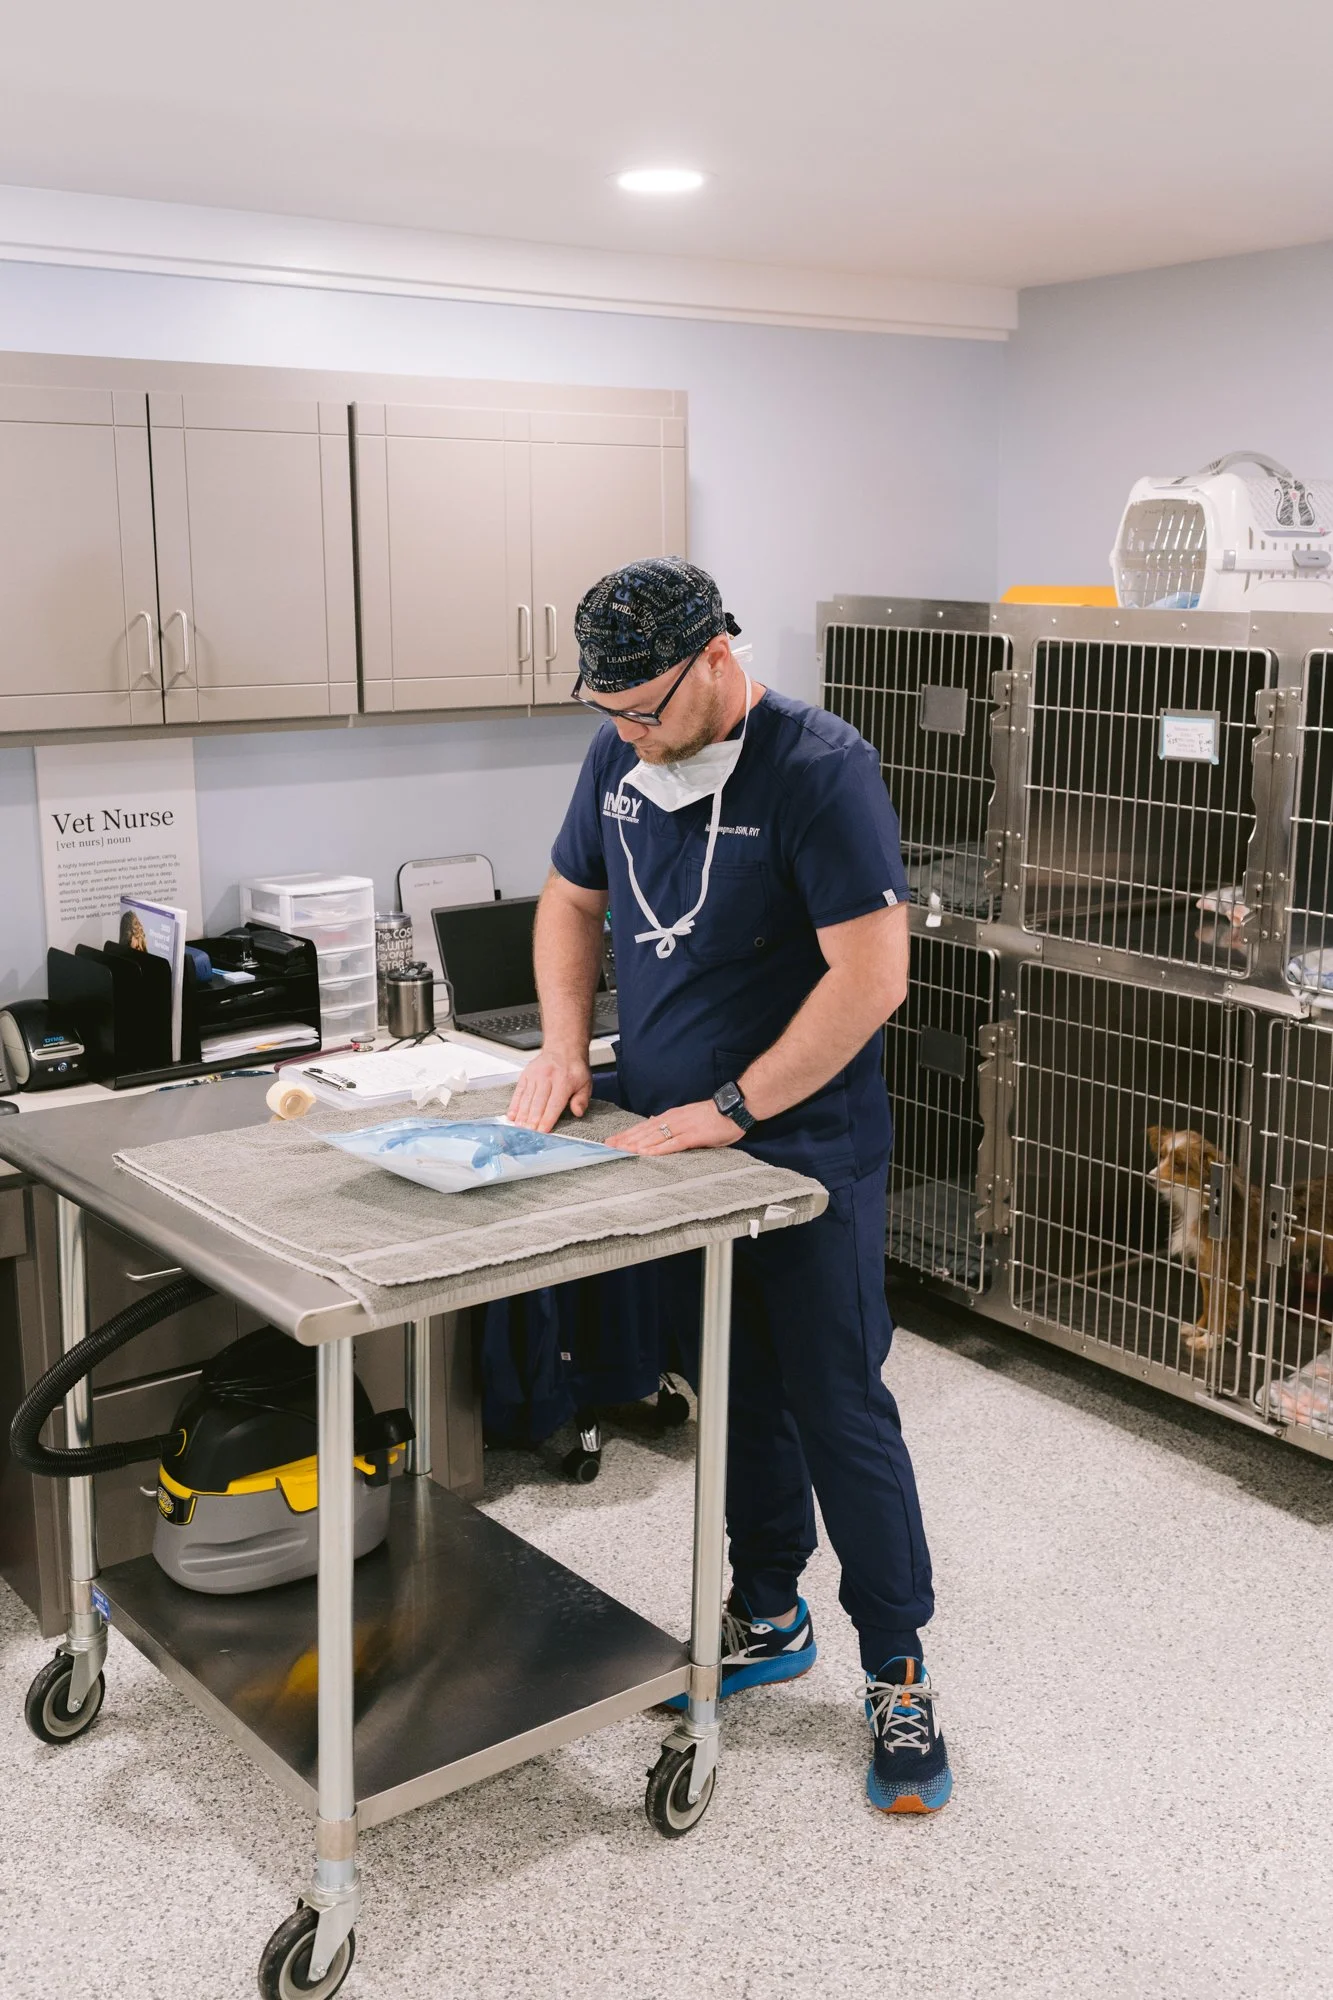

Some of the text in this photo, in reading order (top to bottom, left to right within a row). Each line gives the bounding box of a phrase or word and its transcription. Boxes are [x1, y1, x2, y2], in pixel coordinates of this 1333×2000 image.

[682, 613, 712, 638] LEARNING
[606, 649, 651, 664] LEARNING
[603, 791, 643, 818] INDY
[51, 808, 174, 835] Vet Nurse
[56, 836, 131, 851] [vet nurs] noun
[393, 927, 413, 939] COS
